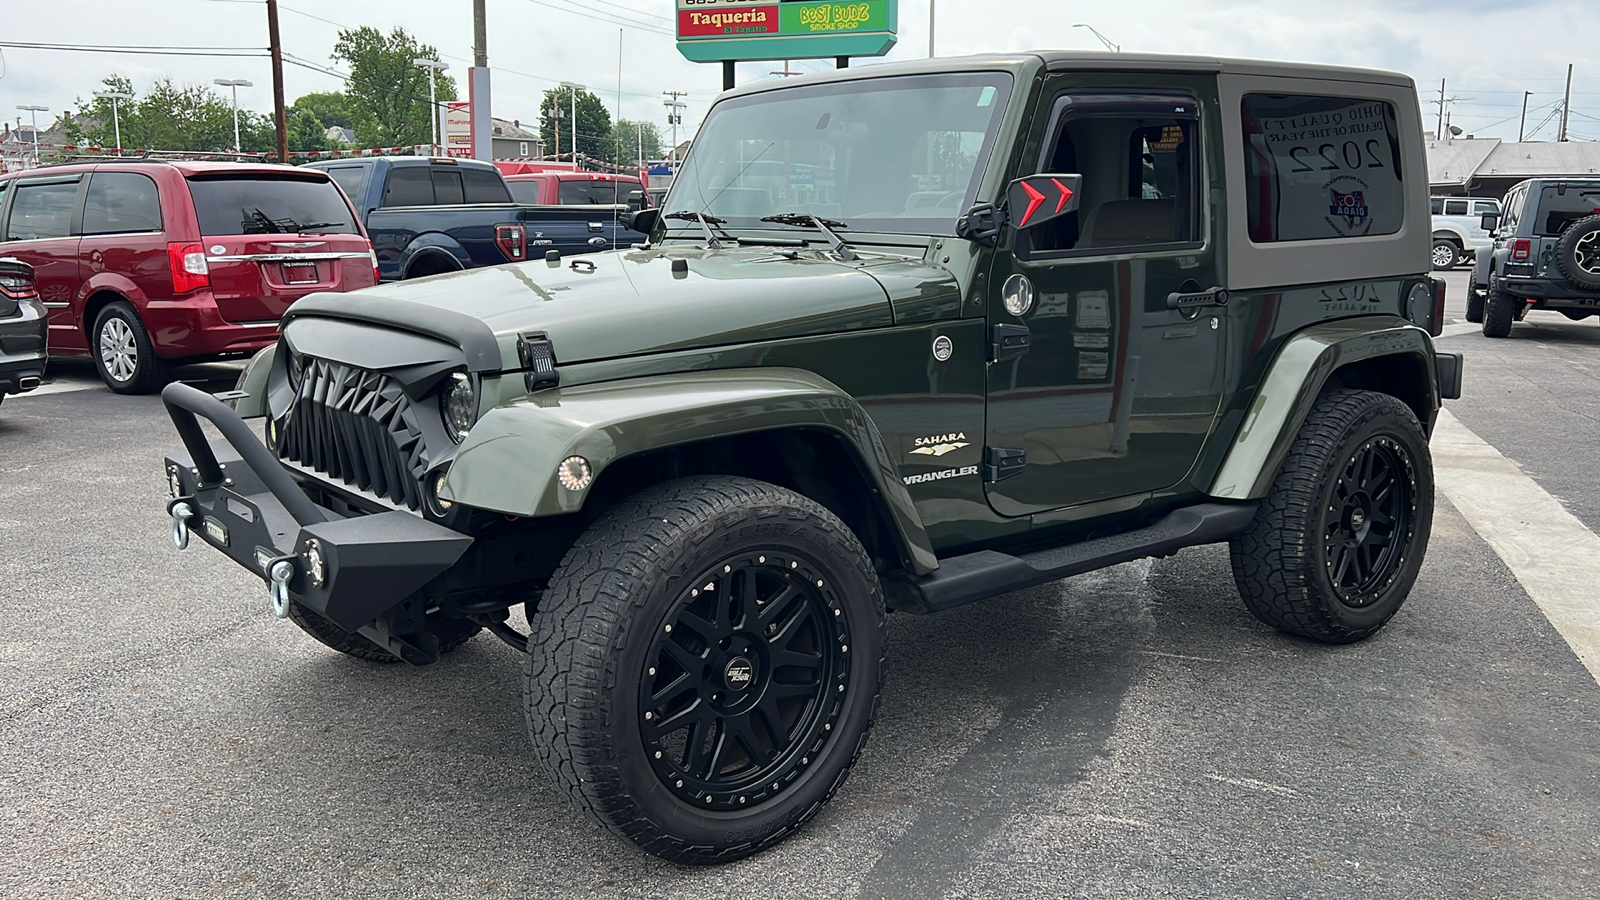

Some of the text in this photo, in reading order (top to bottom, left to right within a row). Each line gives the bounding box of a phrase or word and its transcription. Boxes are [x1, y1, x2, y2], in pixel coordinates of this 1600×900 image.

[810, 23, 835, 31] SMOKE
[914, 432, 966, 446] SAHARA
[718, 522, 840, 554] TERRAIN
